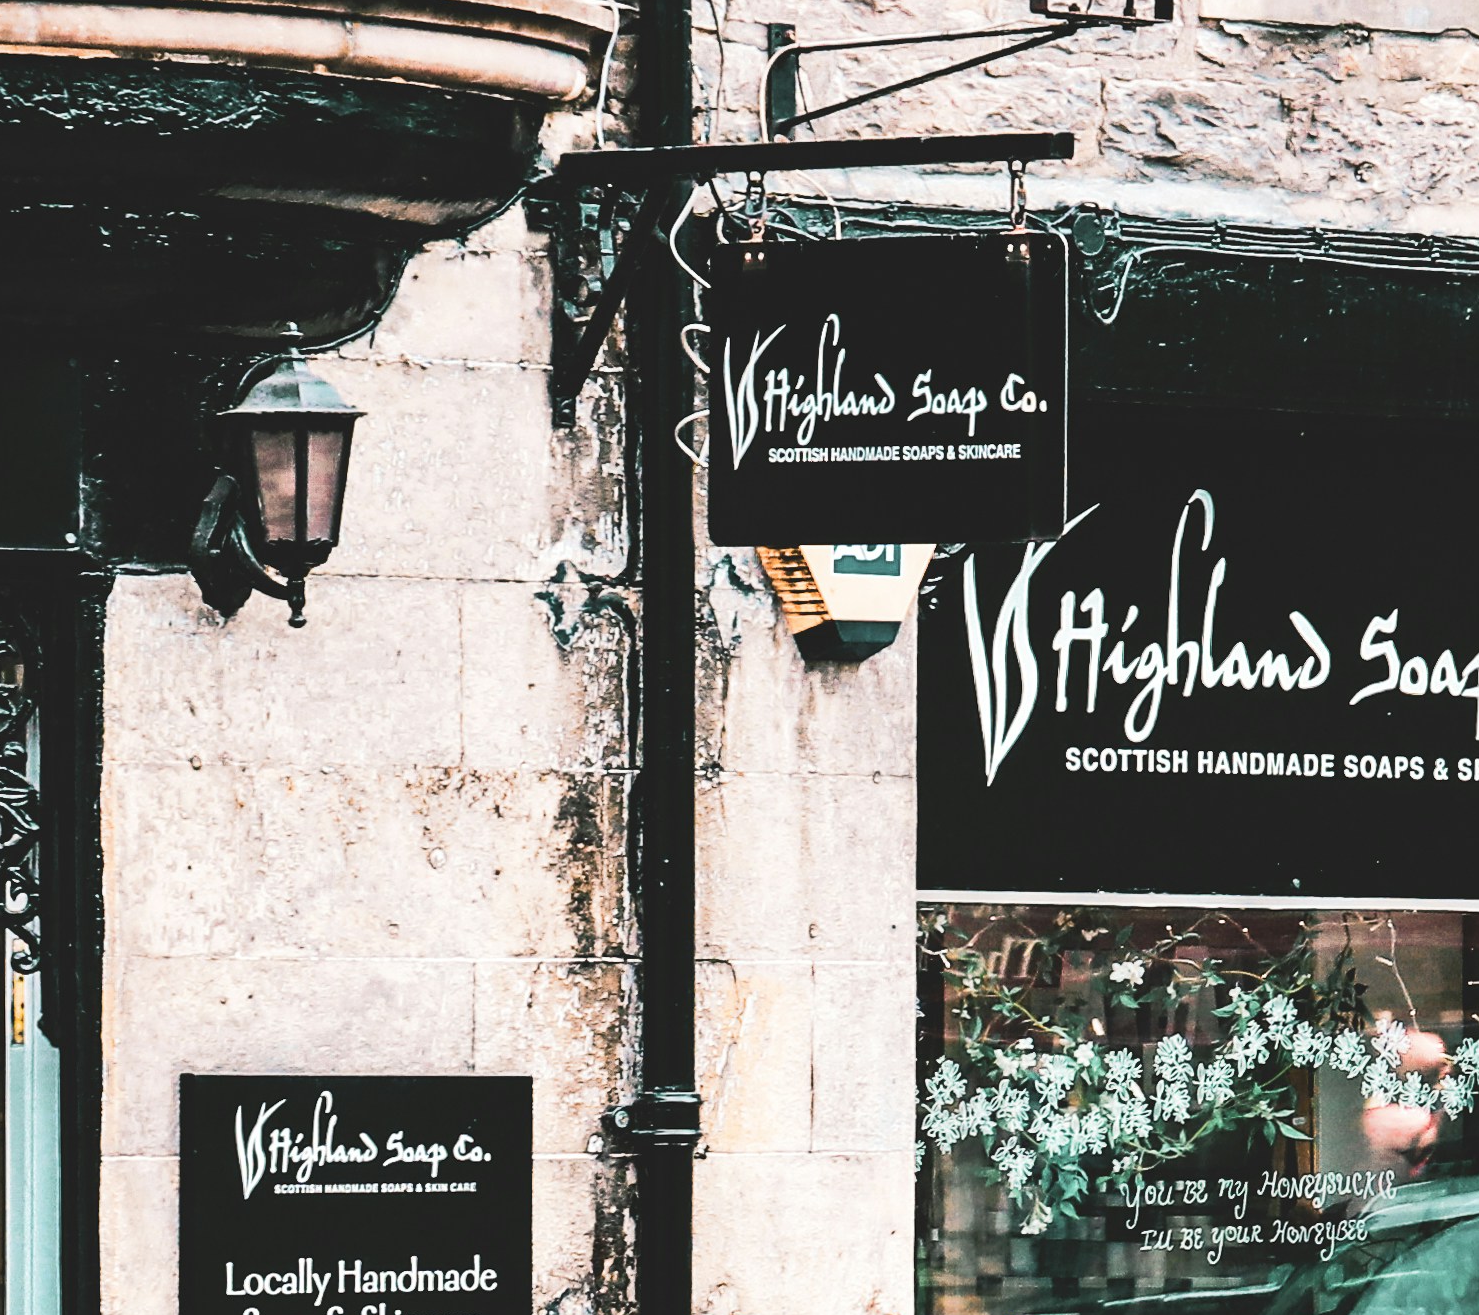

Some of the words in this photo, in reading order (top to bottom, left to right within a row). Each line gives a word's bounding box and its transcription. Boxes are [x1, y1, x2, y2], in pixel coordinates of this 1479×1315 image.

[763, 314, 895, 446] Highland
[907, 369, 987, 437] Soap
[1000, 373, 1047, 412] Co.
[769, 443, 828, 462] SCOTTISH
[831, 446, 900, 462] HANDMADE
[903, 445, 944, 460] SOAPS
[947, 445, 956, 460] &
[958, 444, 1021, 460] SKINCARE
[1052, 488, 1331, 742] Highland
[1066, 747, 1188, 773] SCOTTISH
[1198, 751, 1334, 777] HANDMADE
[1344, 755, 1424, 780] SOAPS
[1433, 758, 1448, 780] &
[268, 1091, 378, 1183] Highland
[383, 1131, 448, 1178] Soap
[453, 1134, 491, 1161] Co.
[274, 1184, 322, 1194] SCOTTISH
[325, 1183, 378, 1193] HANDMADE
[381, 1183, 413, 1193] SOAPS
[425, 1183, 448, 1192] SKIN
[450, 1182, 476, 1192] CARE
[226, 1258, 331, 1306] Locally
[338, 1254, 497, 1293] Handmade
